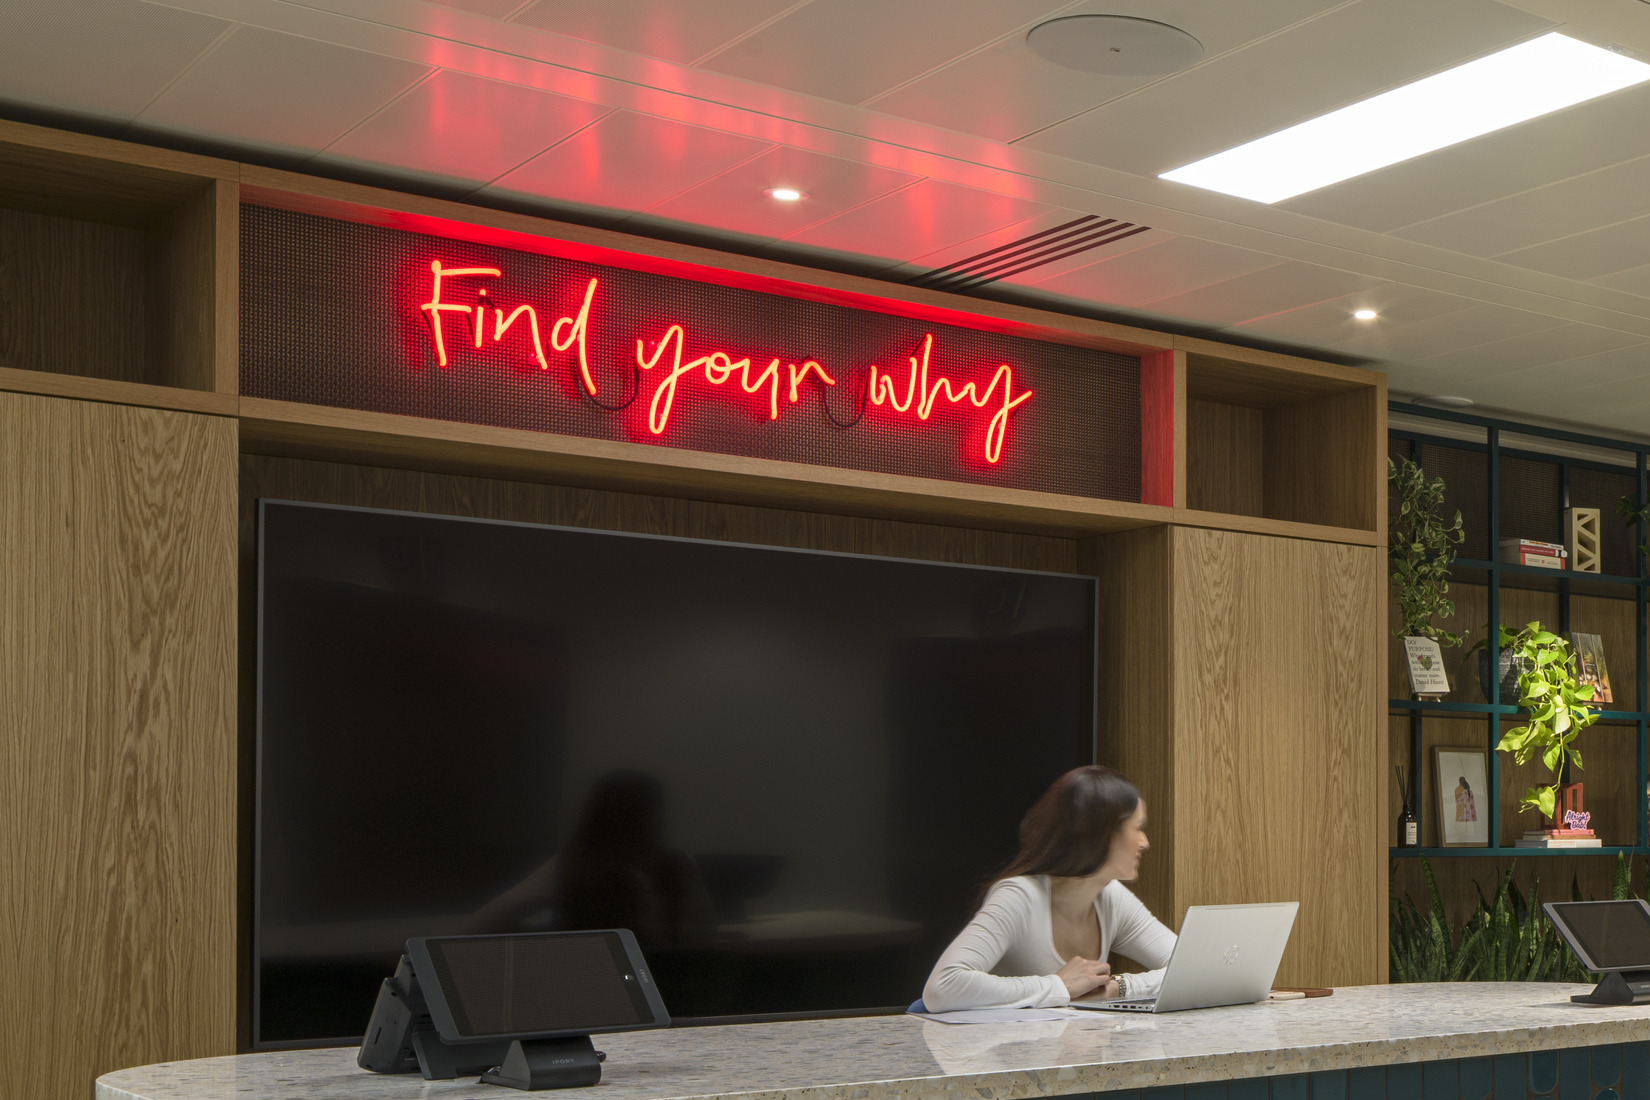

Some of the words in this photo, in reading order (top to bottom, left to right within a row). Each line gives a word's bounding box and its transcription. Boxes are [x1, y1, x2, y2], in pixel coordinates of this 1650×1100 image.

[420, 258, 598, 395] Find
[635, 324, 836, 435] your
[868, 332, 1033, 464] why
